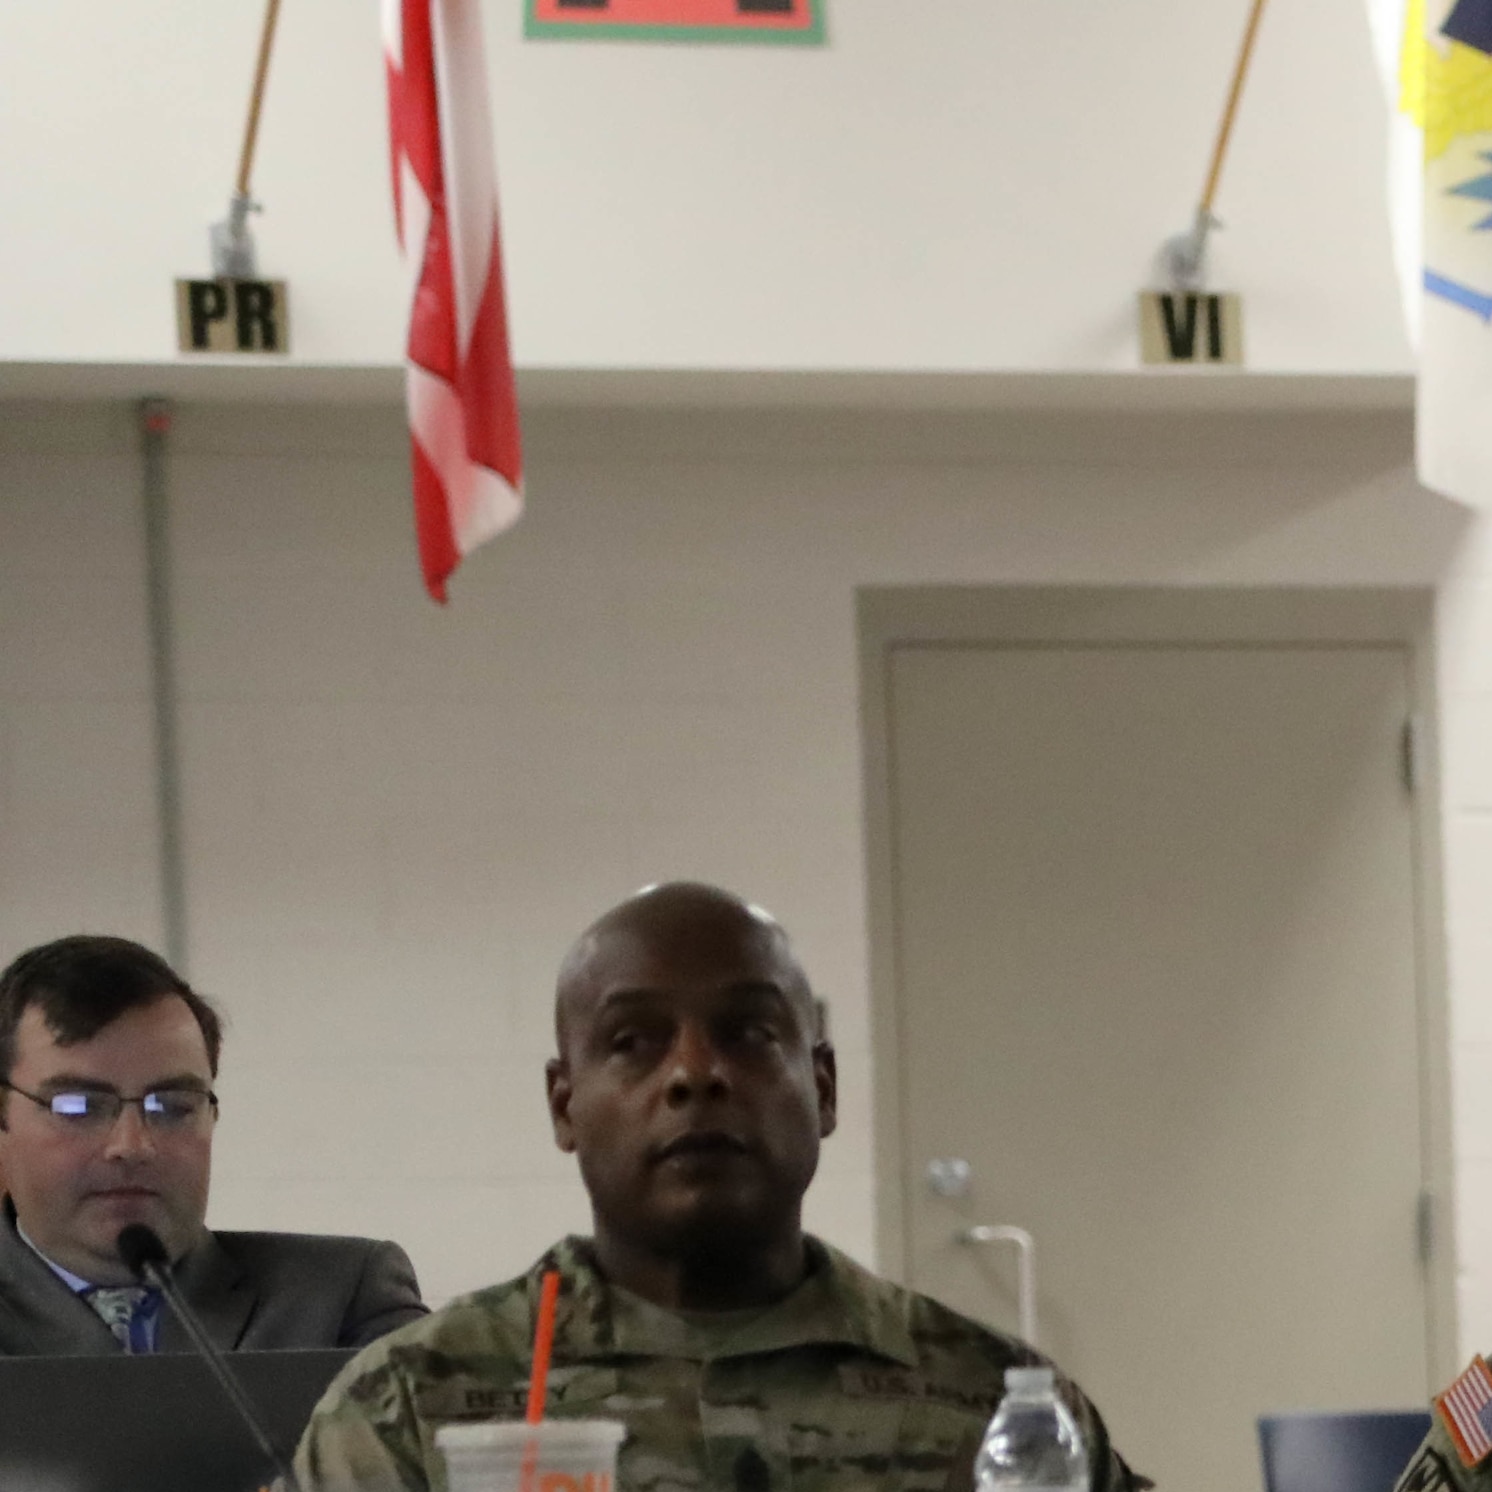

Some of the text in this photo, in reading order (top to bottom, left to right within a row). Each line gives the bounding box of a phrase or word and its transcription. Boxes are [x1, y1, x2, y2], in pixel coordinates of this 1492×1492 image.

[189, 280, 277, 351] PR
[1160, 293, 1222, 360] VI
[465, 1384, 568, 1408] BETY
